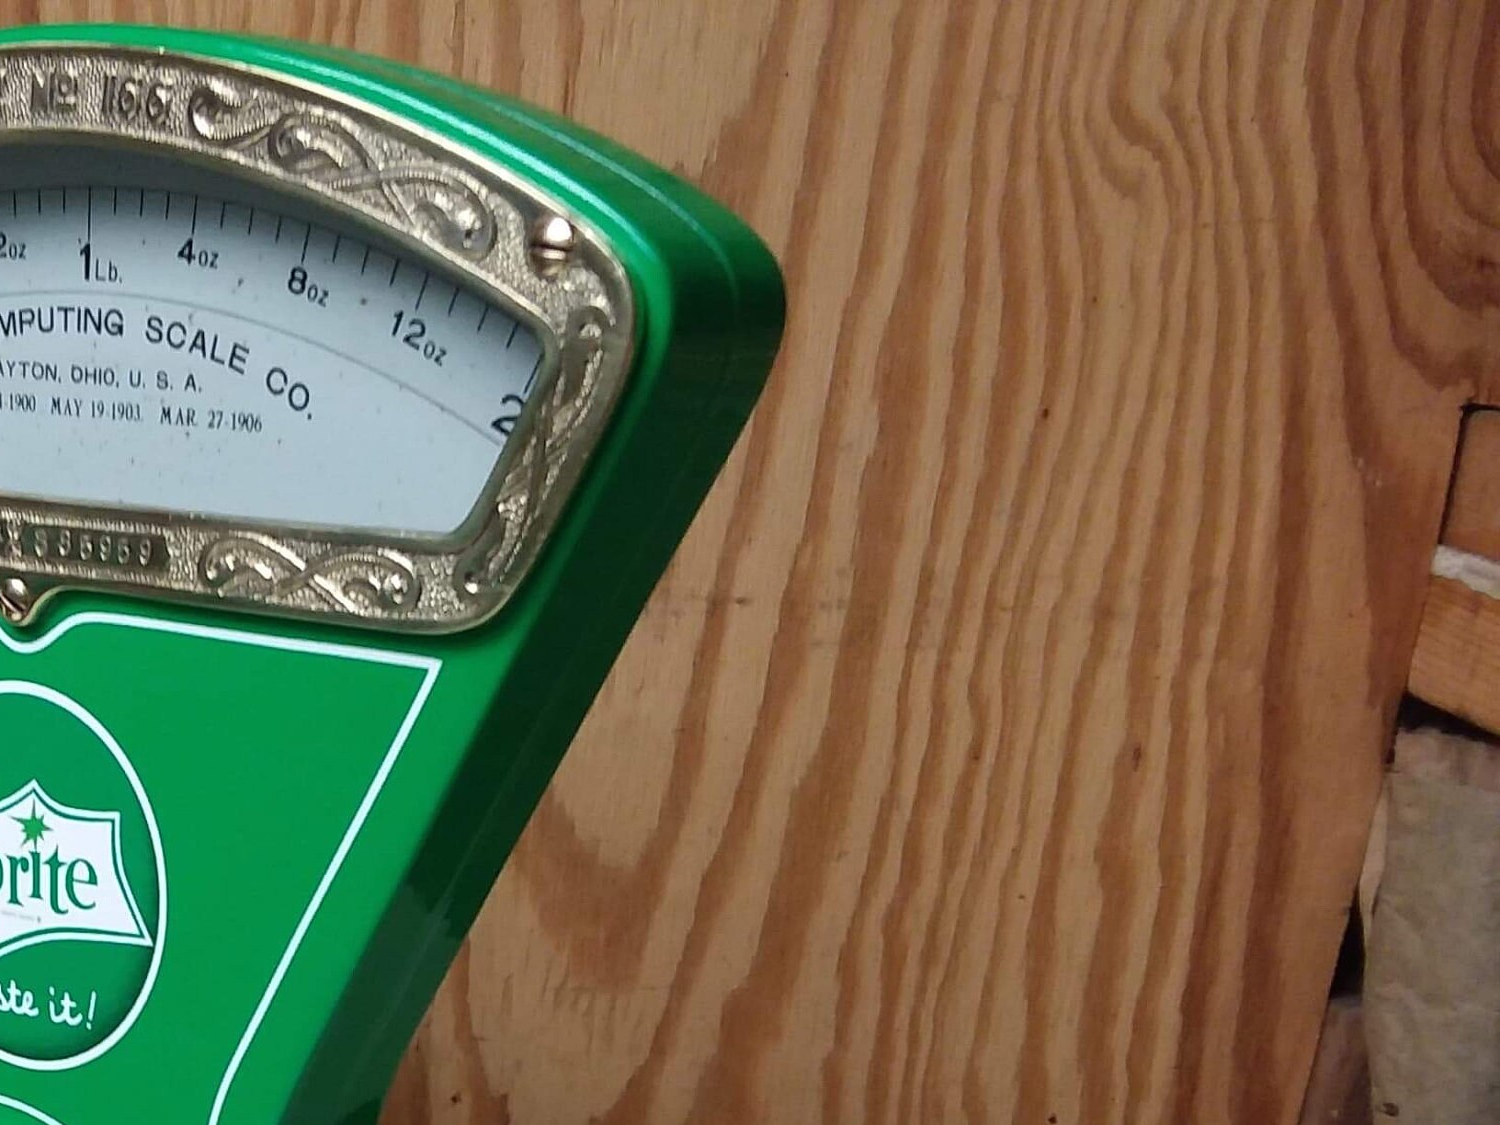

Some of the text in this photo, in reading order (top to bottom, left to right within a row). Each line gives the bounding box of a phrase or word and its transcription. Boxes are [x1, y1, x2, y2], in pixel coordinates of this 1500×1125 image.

[101, 75, 172, 126] 166
[145, 316, 251, 376] SCALE
[265, 366, 313, 421] CO.
[50, 396, 83, 419] MAY
[491, 393, 525, 437] 2
[48, 984, 98, 1030] it!
